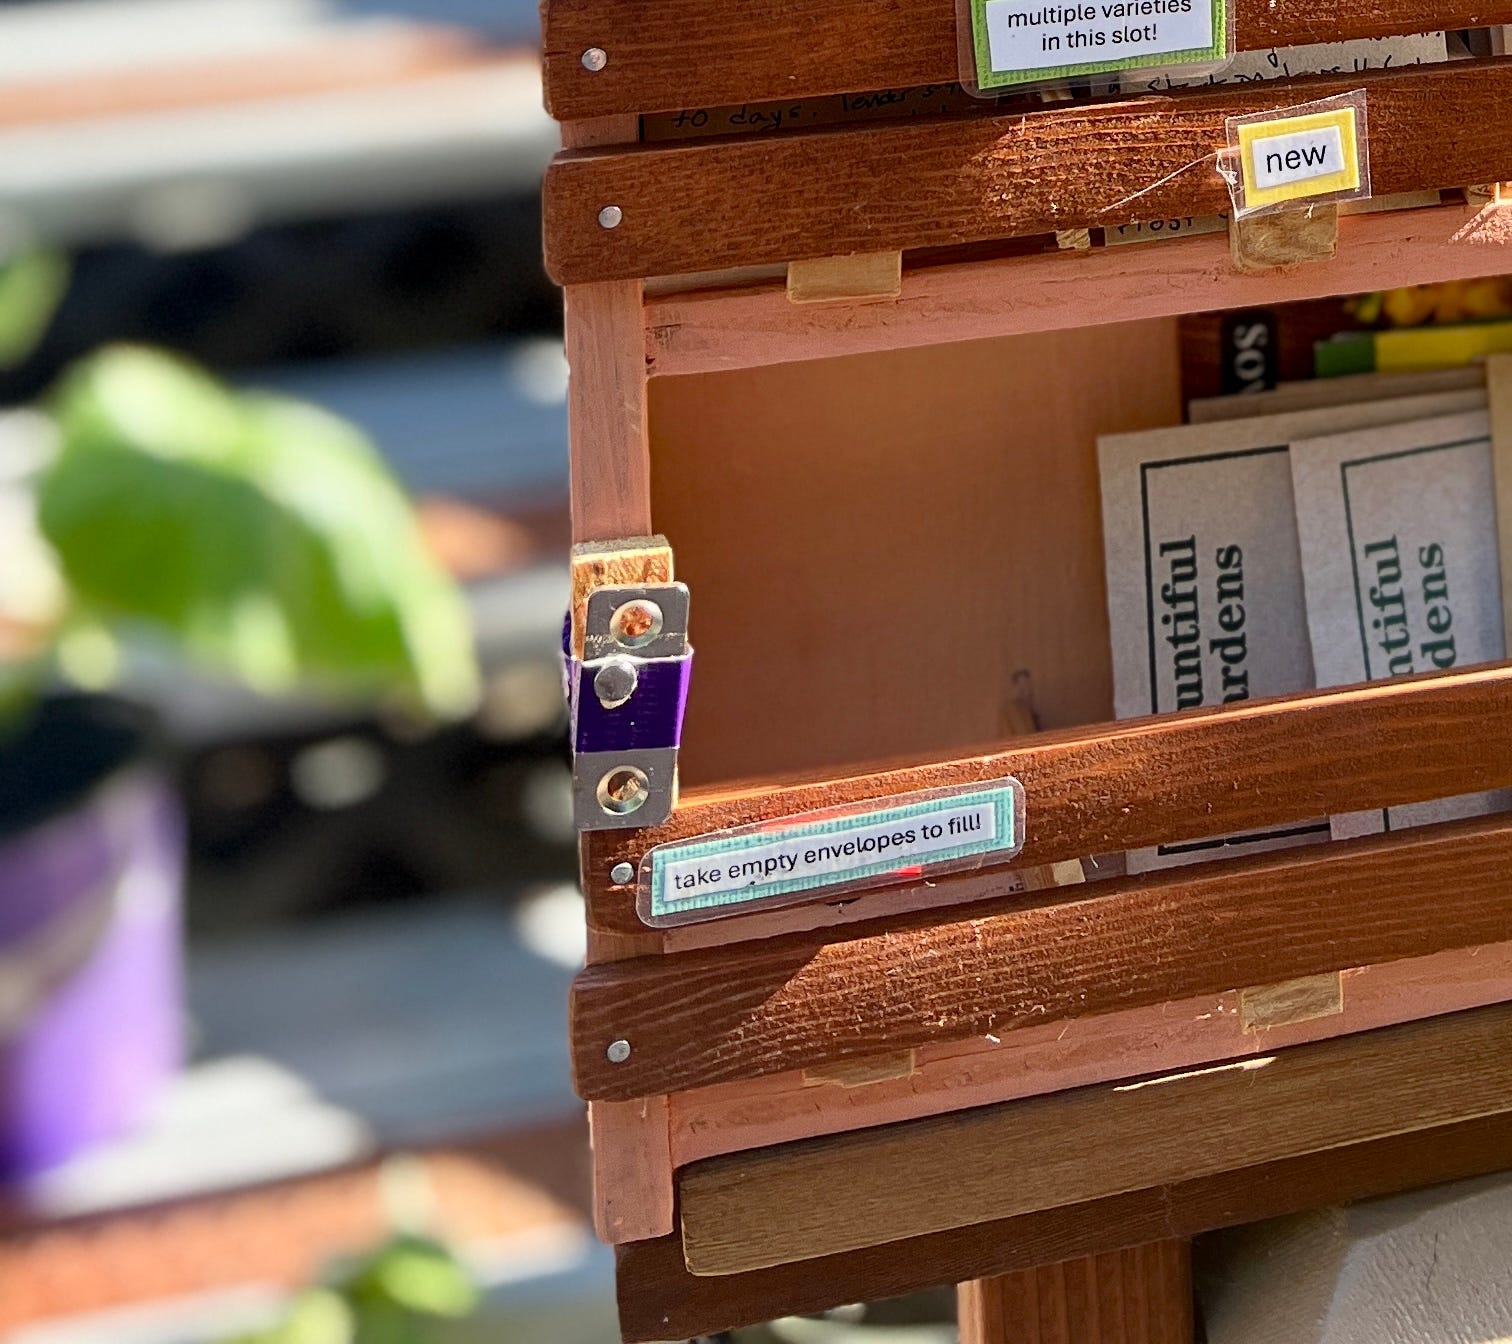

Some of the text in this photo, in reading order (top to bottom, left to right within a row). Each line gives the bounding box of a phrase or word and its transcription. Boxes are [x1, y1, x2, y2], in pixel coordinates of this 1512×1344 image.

[1007, 1, 1097, 30] multiple
[1041, 23, 1159, 52] in this slot!
[1265, 144, 1328, 175] new
[673, 812, 983, 891] take empty envelopes to fill!
